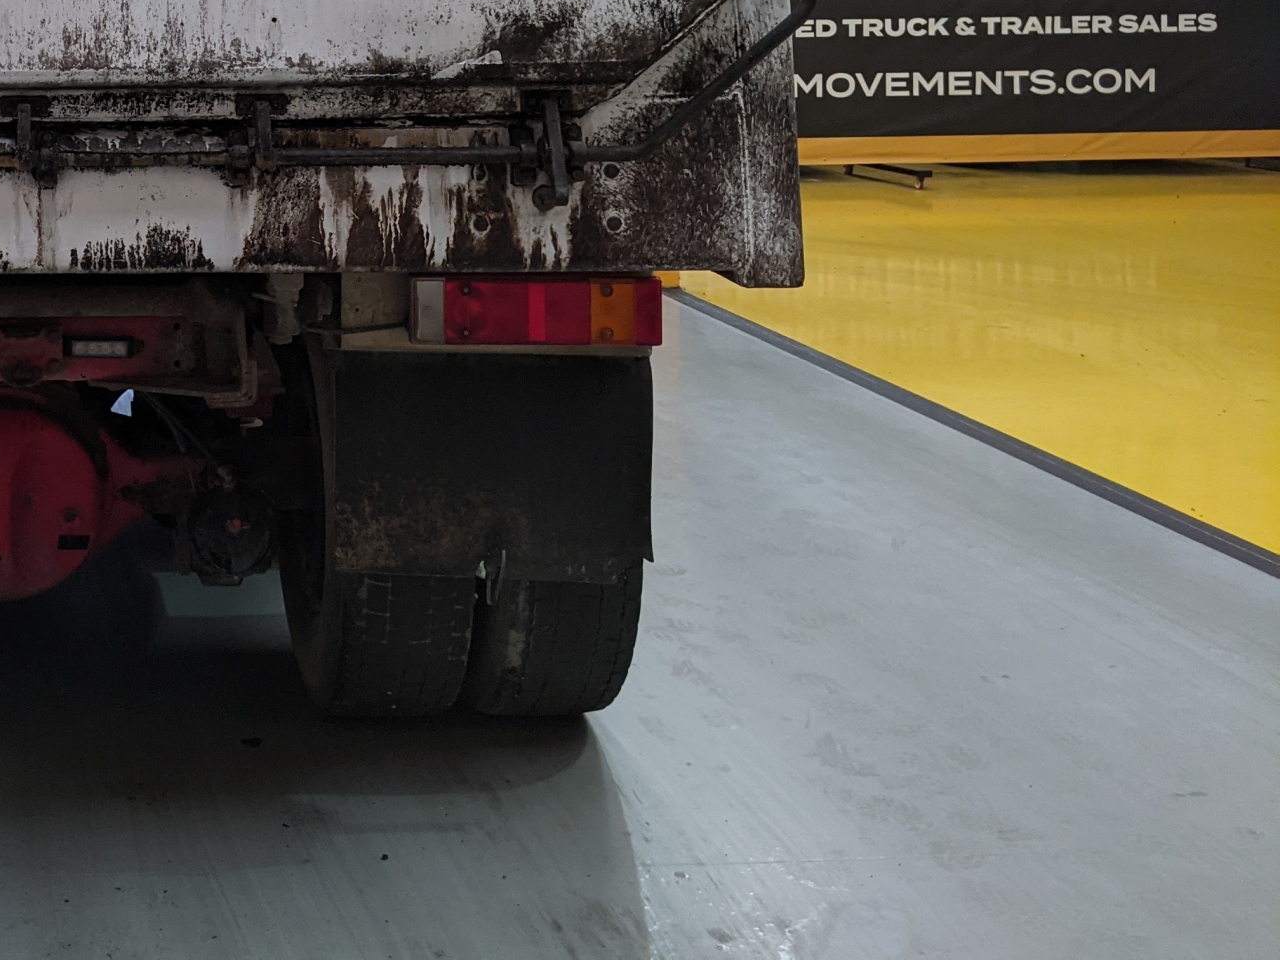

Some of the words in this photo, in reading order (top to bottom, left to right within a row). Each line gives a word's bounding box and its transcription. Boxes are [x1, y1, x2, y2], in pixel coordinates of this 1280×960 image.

[842, 16, 949, 38] TRUCK
[955, 17, 976, 36] &
[981, 14, 1112, 36] TRAILER
[1118, 13, 1218, 34] SALES
[793, 68, 1157, 99] MOVEMENTS.COM
